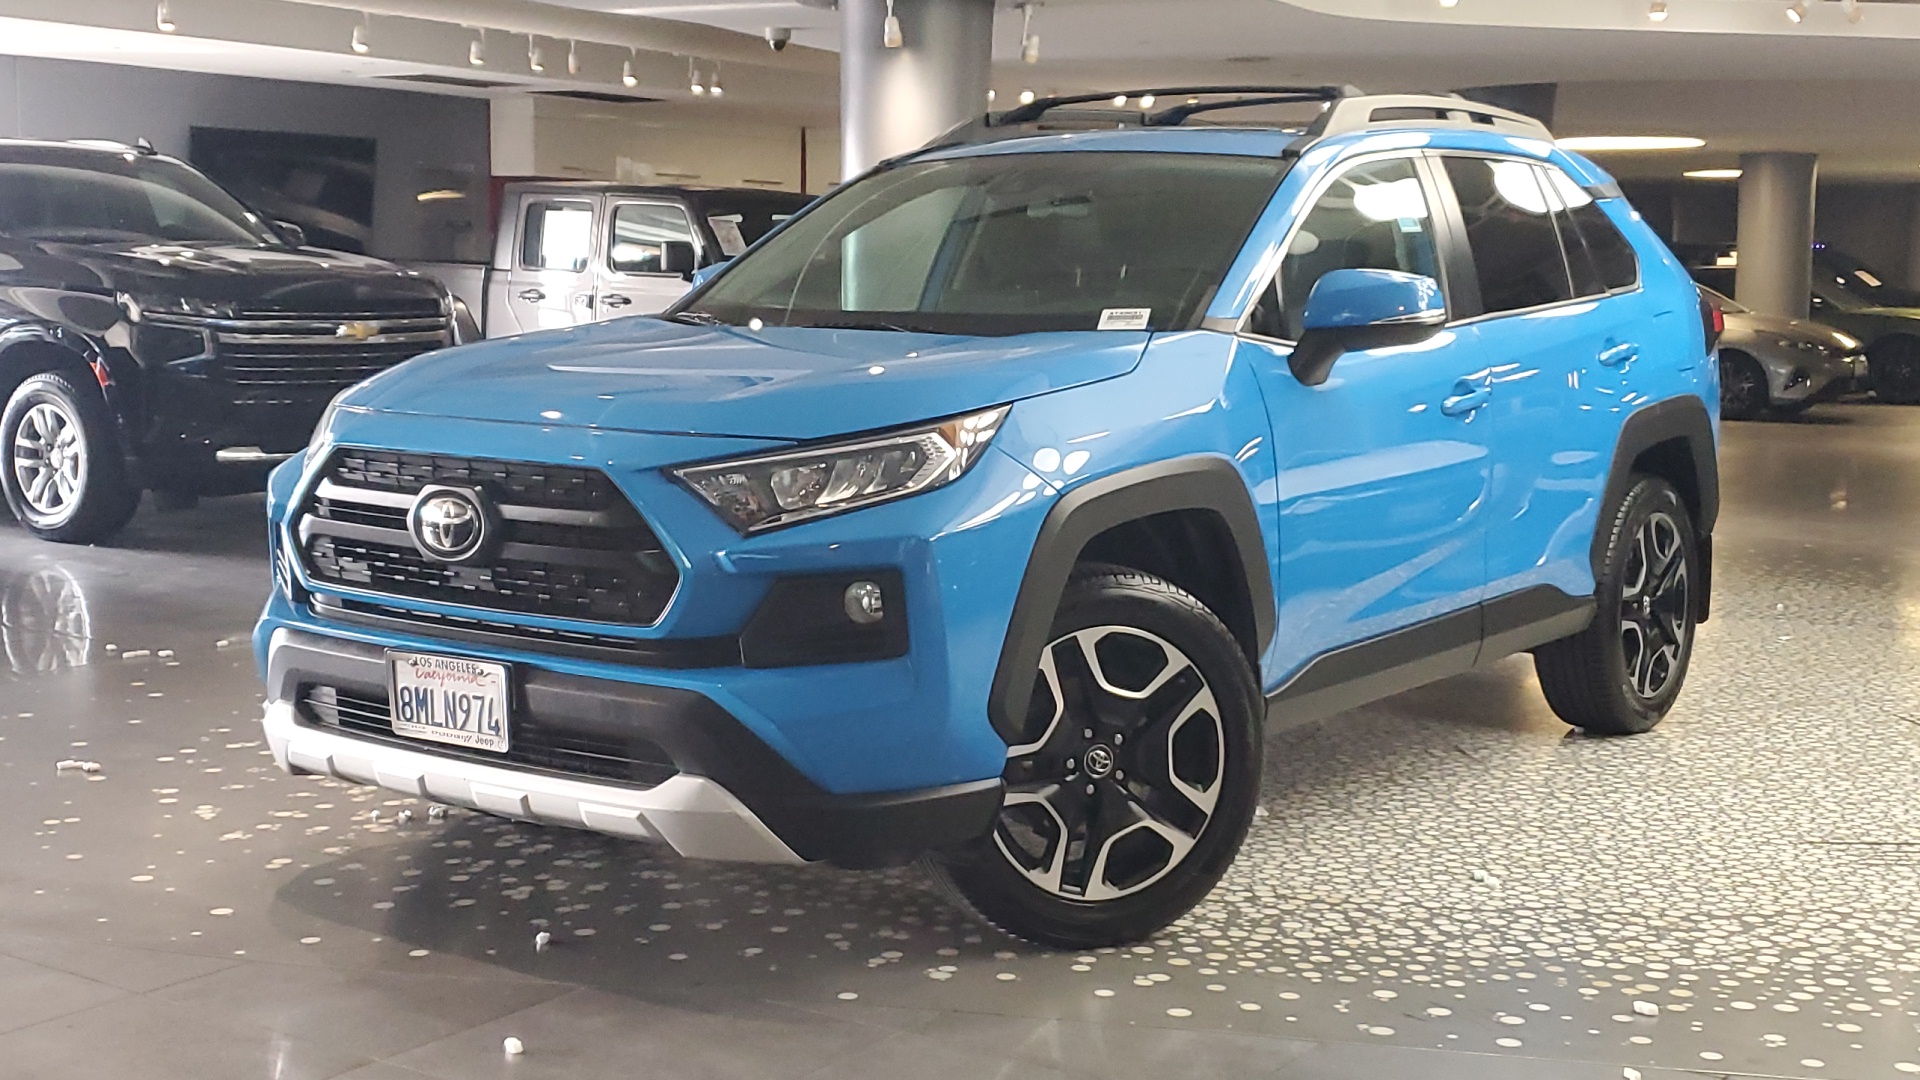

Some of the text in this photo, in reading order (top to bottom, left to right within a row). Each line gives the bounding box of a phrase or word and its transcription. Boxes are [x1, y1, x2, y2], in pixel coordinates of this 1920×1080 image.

[416, 656, 477, 673] LOS ANGELES
[400, 686, 500, 736] 8MLN974
[475, 736, 494, 748] Jeep
